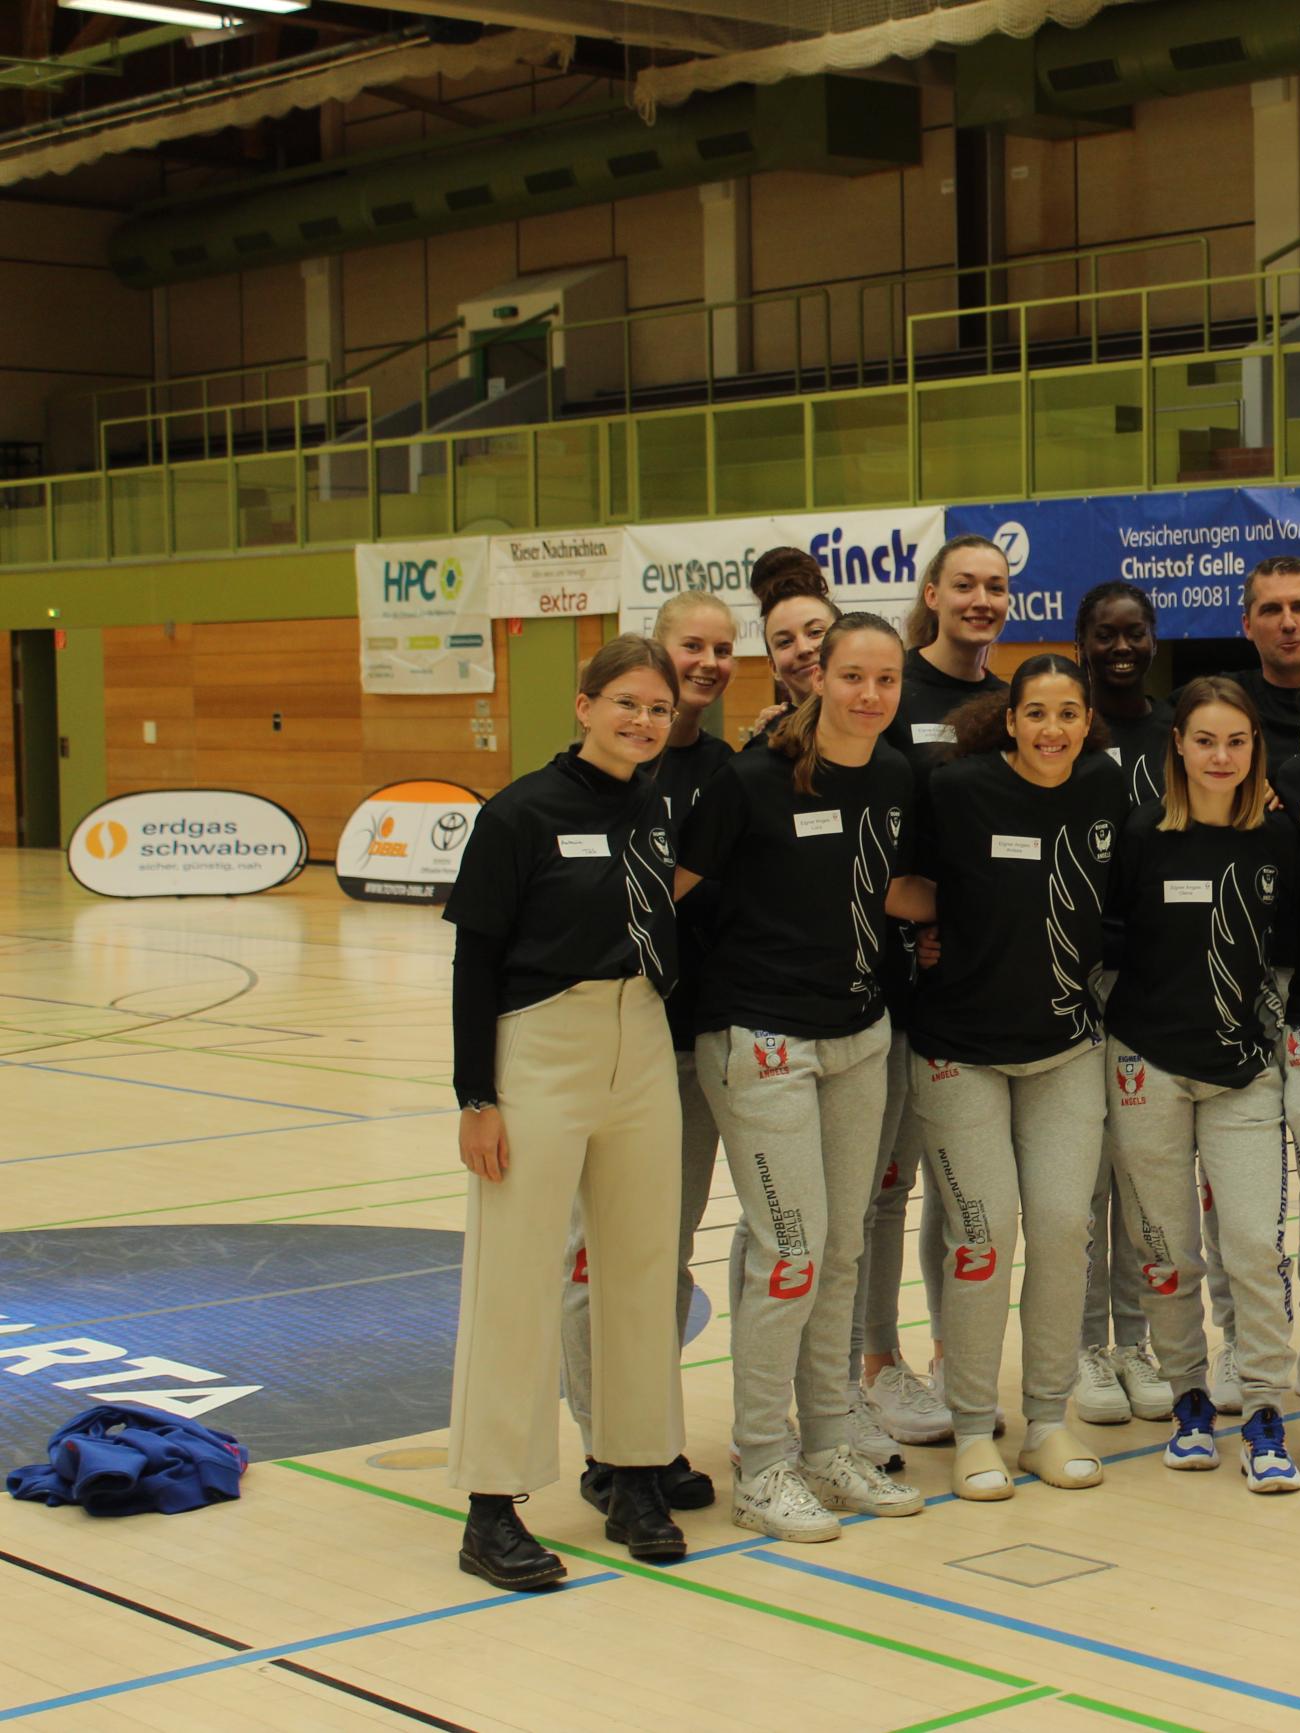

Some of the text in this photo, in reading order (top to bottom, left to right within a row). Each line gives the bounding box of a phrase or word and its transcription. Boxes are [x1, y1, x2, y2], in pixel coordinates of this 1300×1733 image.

[1120, 523, 1240, 549] Versicherungen
[1244, 520, 1274, 542] und
[1120, 552, 1245, 580] Christof Gelle
[383, 559, 437, 602] HPC
[540, 586, 588, 613] extra
[1182, 586, 1230, 607] 09081
[142, 818, 238, 839] erdgas
[140, 839, 287, 857] schwaben
[931, 1067, 960, 1082] ANGELS
[754, 1153, 791, 1258] WERBEZENTRUM
[938, 1148, 977, 1243] WERBEZENTRUM
[783, 1209, 803, 1257] OSTALB
[967, 1200, 986, 1245] OSTALB
